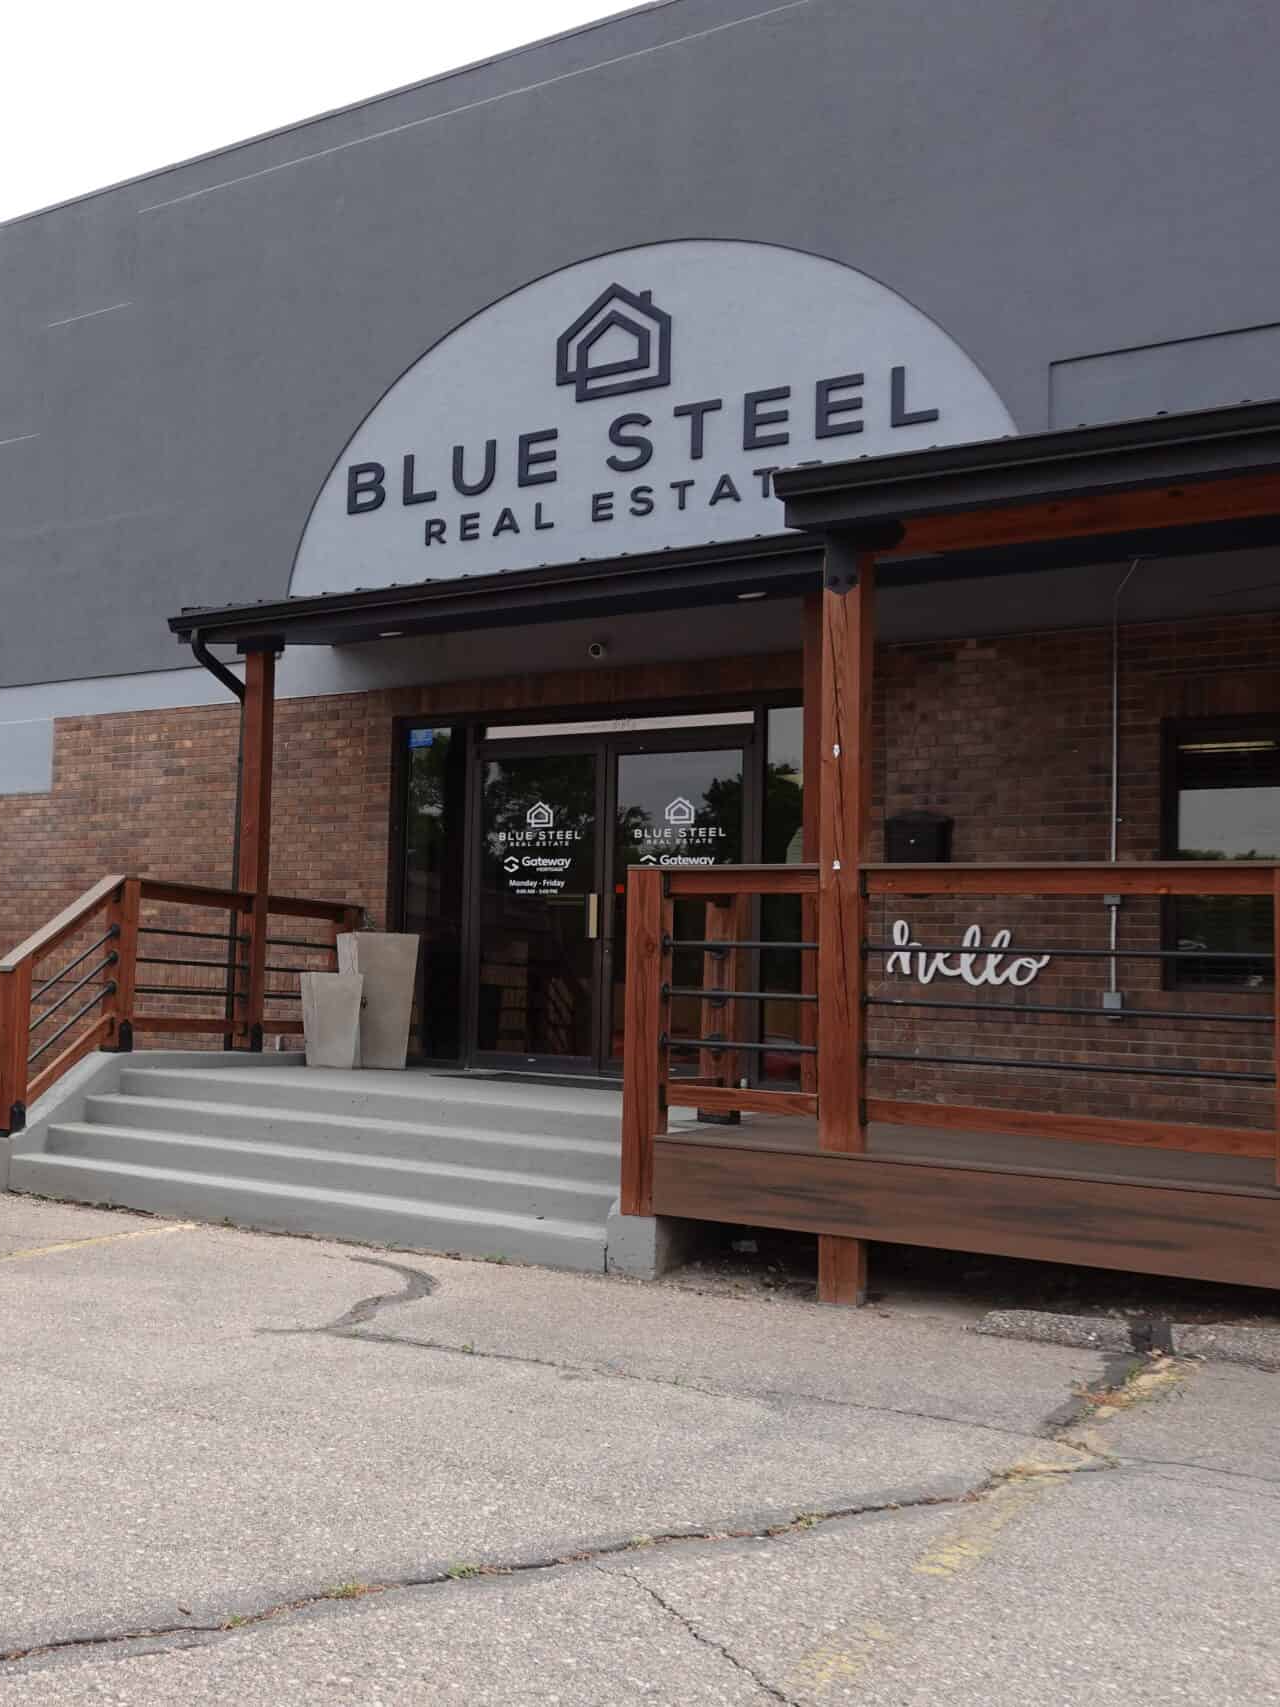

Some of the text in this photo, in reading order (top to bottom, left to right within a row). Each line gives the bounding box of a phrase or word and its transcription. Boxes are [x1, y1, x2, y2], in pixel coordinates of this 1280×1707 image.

[346, 366, 940, 515] BLUE STEEL
[424, 460, 823, 547] REAL ESTAT
[498, 829, 582, 841] BLUE STEEL
[633, 826, 727, 839] BLUE STEEL
[521, 856, 572, 869] Gateway
[659, 854, 715, 865] Gateway
[886, 919, 1051, 986] hello
